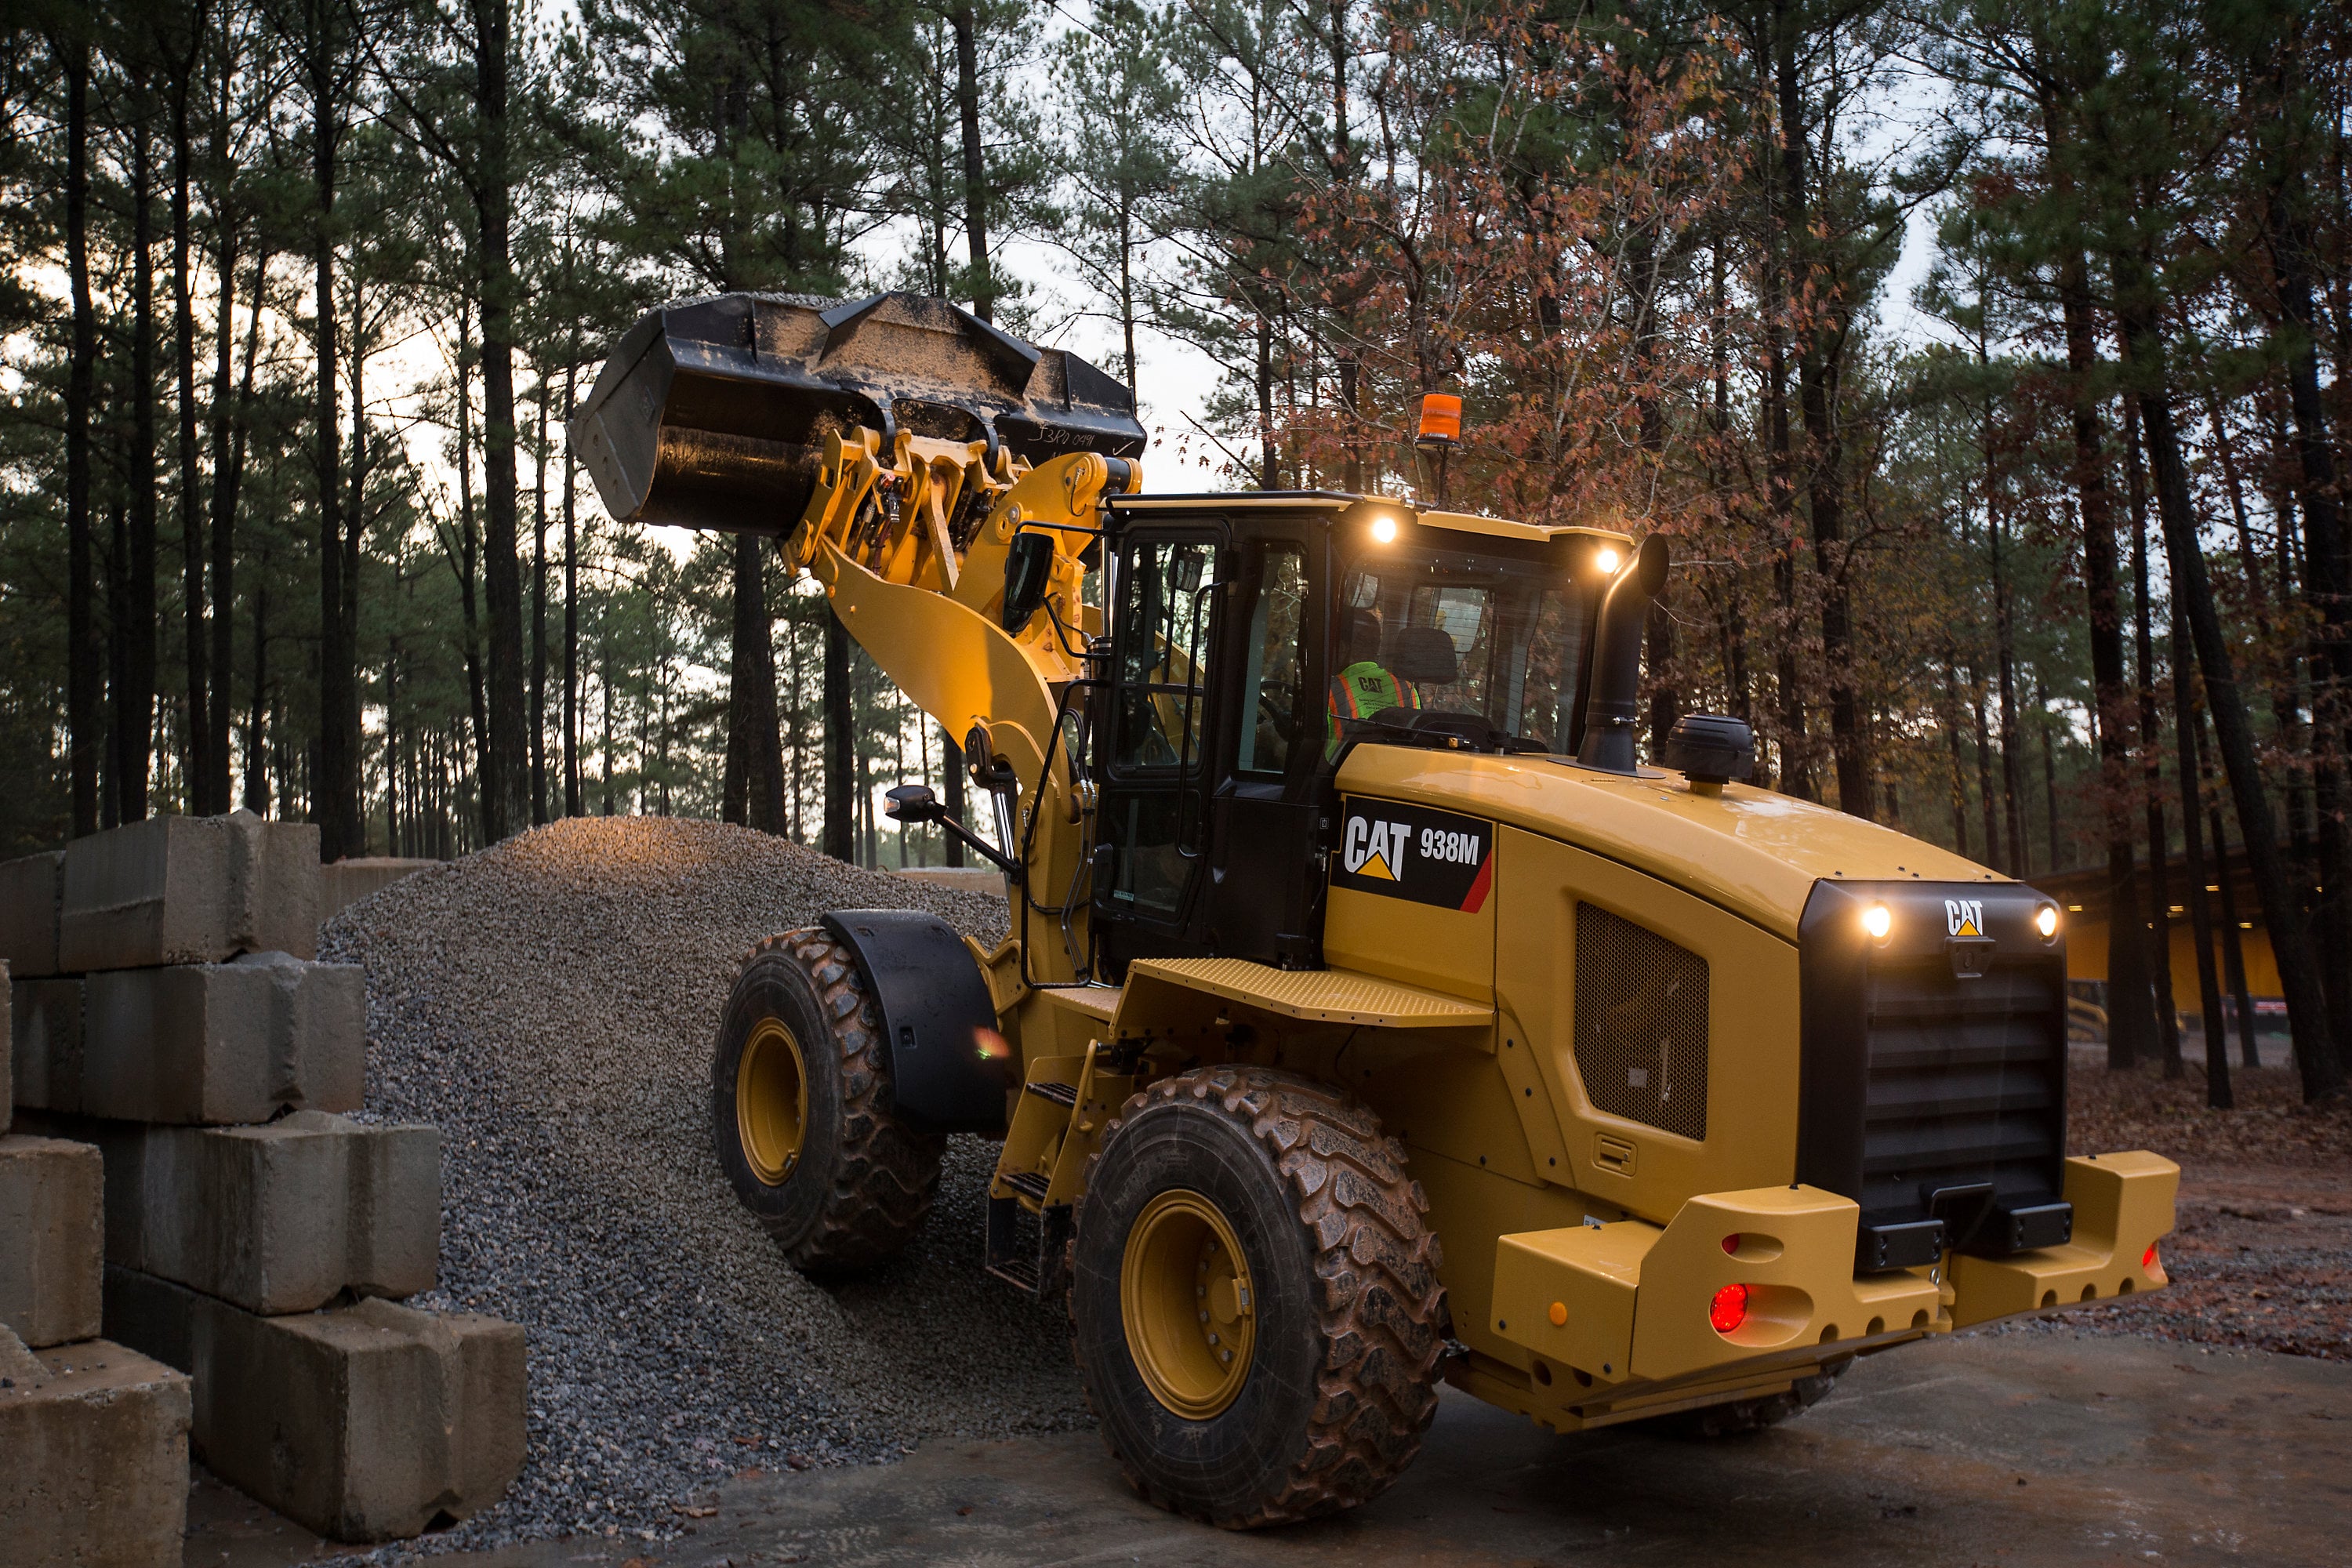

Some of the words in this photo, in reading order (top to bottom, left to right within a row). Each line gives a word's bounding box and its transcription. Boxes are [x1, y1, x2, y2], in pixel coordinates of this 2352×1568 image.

[1358, 677, 1383, 693] CAT
[1344, 816, 1411, 882] CAT
[1421, 828, 1479, 866] 938M
[1944, 900, 1983, 936] CAT
